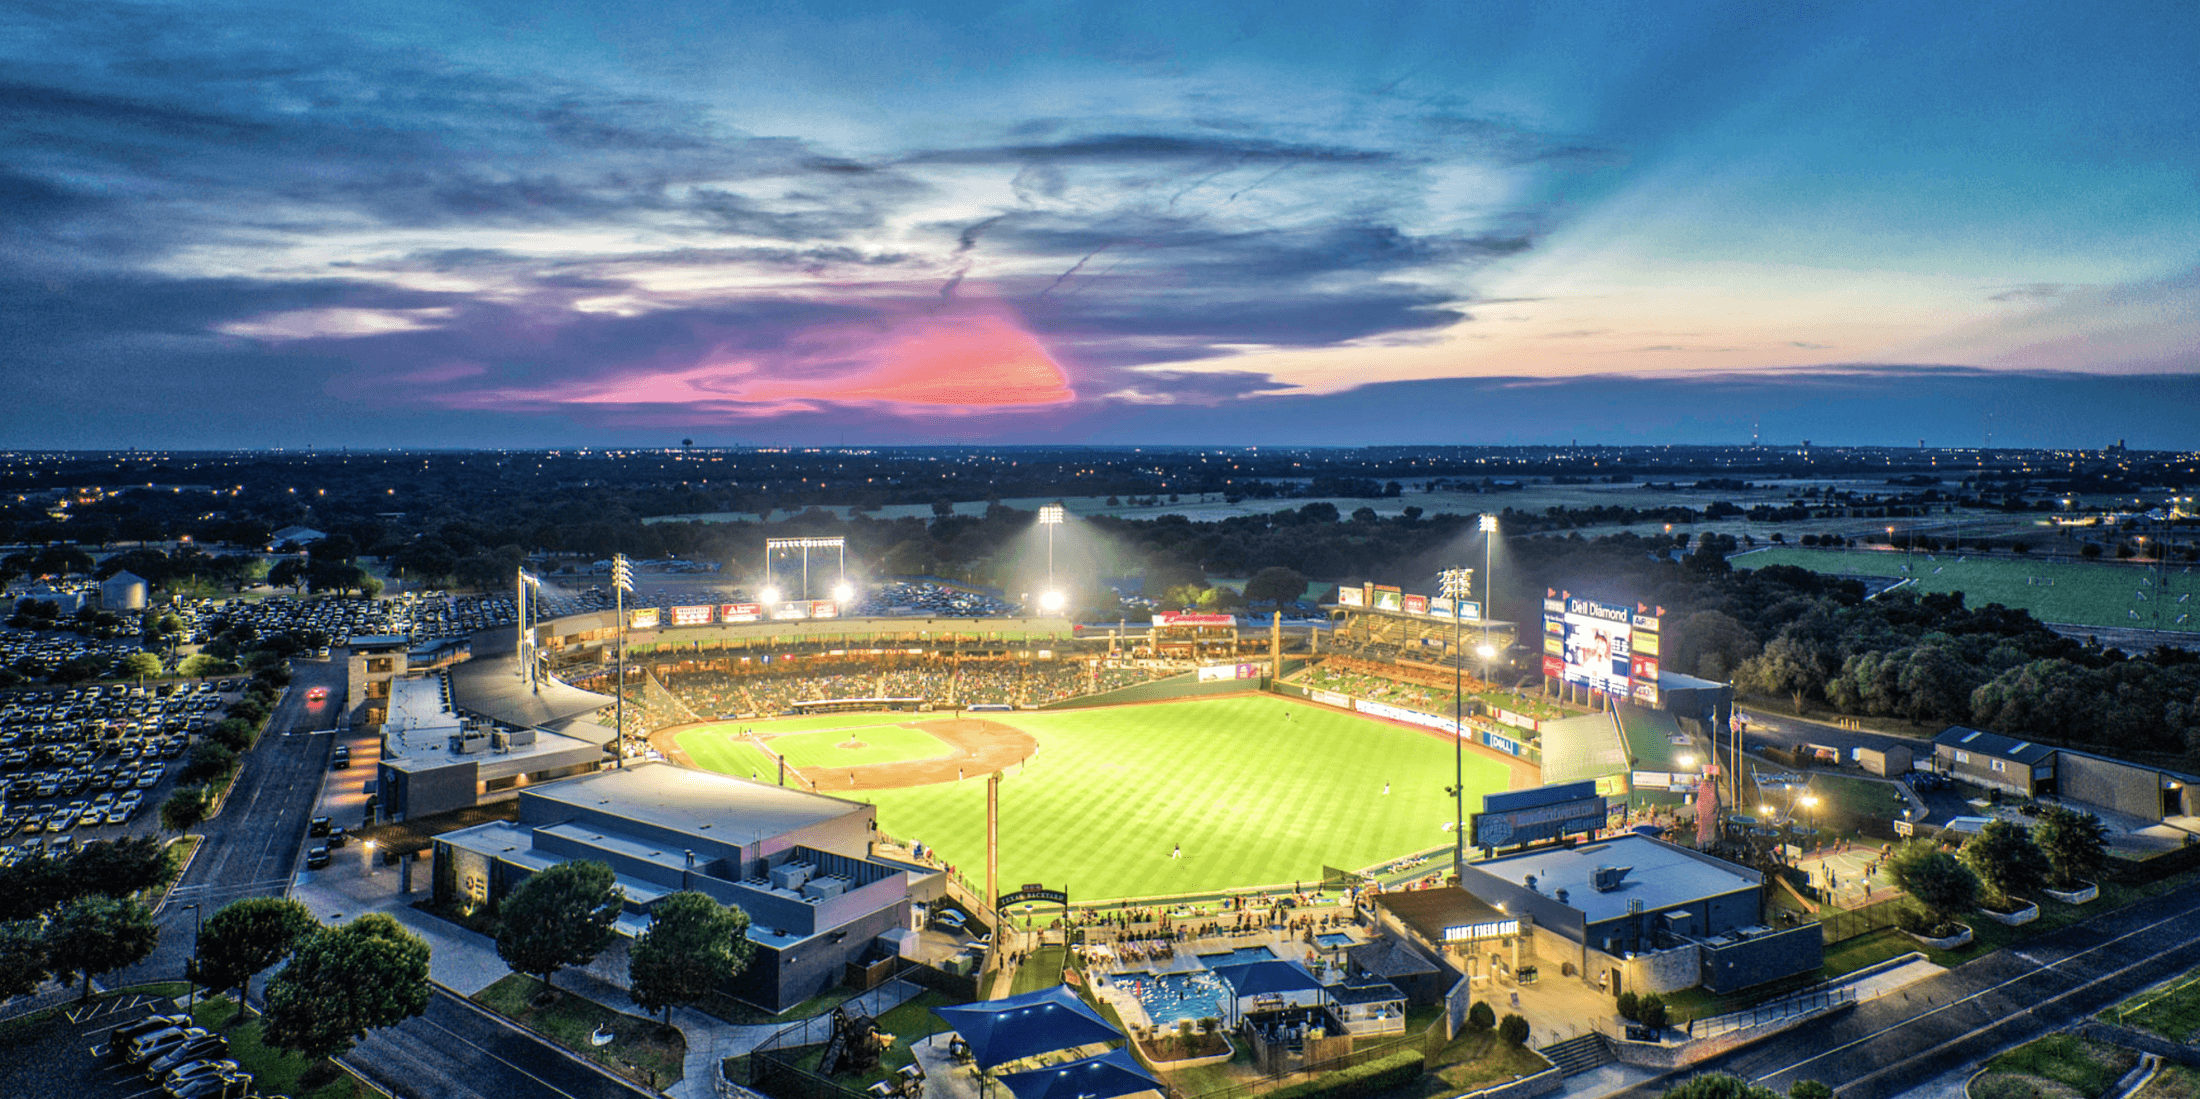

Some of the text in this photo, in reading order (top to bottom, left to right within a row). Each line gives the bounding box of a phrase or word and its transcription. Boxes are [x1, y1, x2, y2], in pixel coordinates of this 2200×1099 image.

[1571, 599, 1588, 616] Dell
[1589, 602, 1628, 623] Diamond
[1027, 892, 1064, 901] BACKYARD
[1444, 919, 1519, 941] RIGHT FIELD GATE
